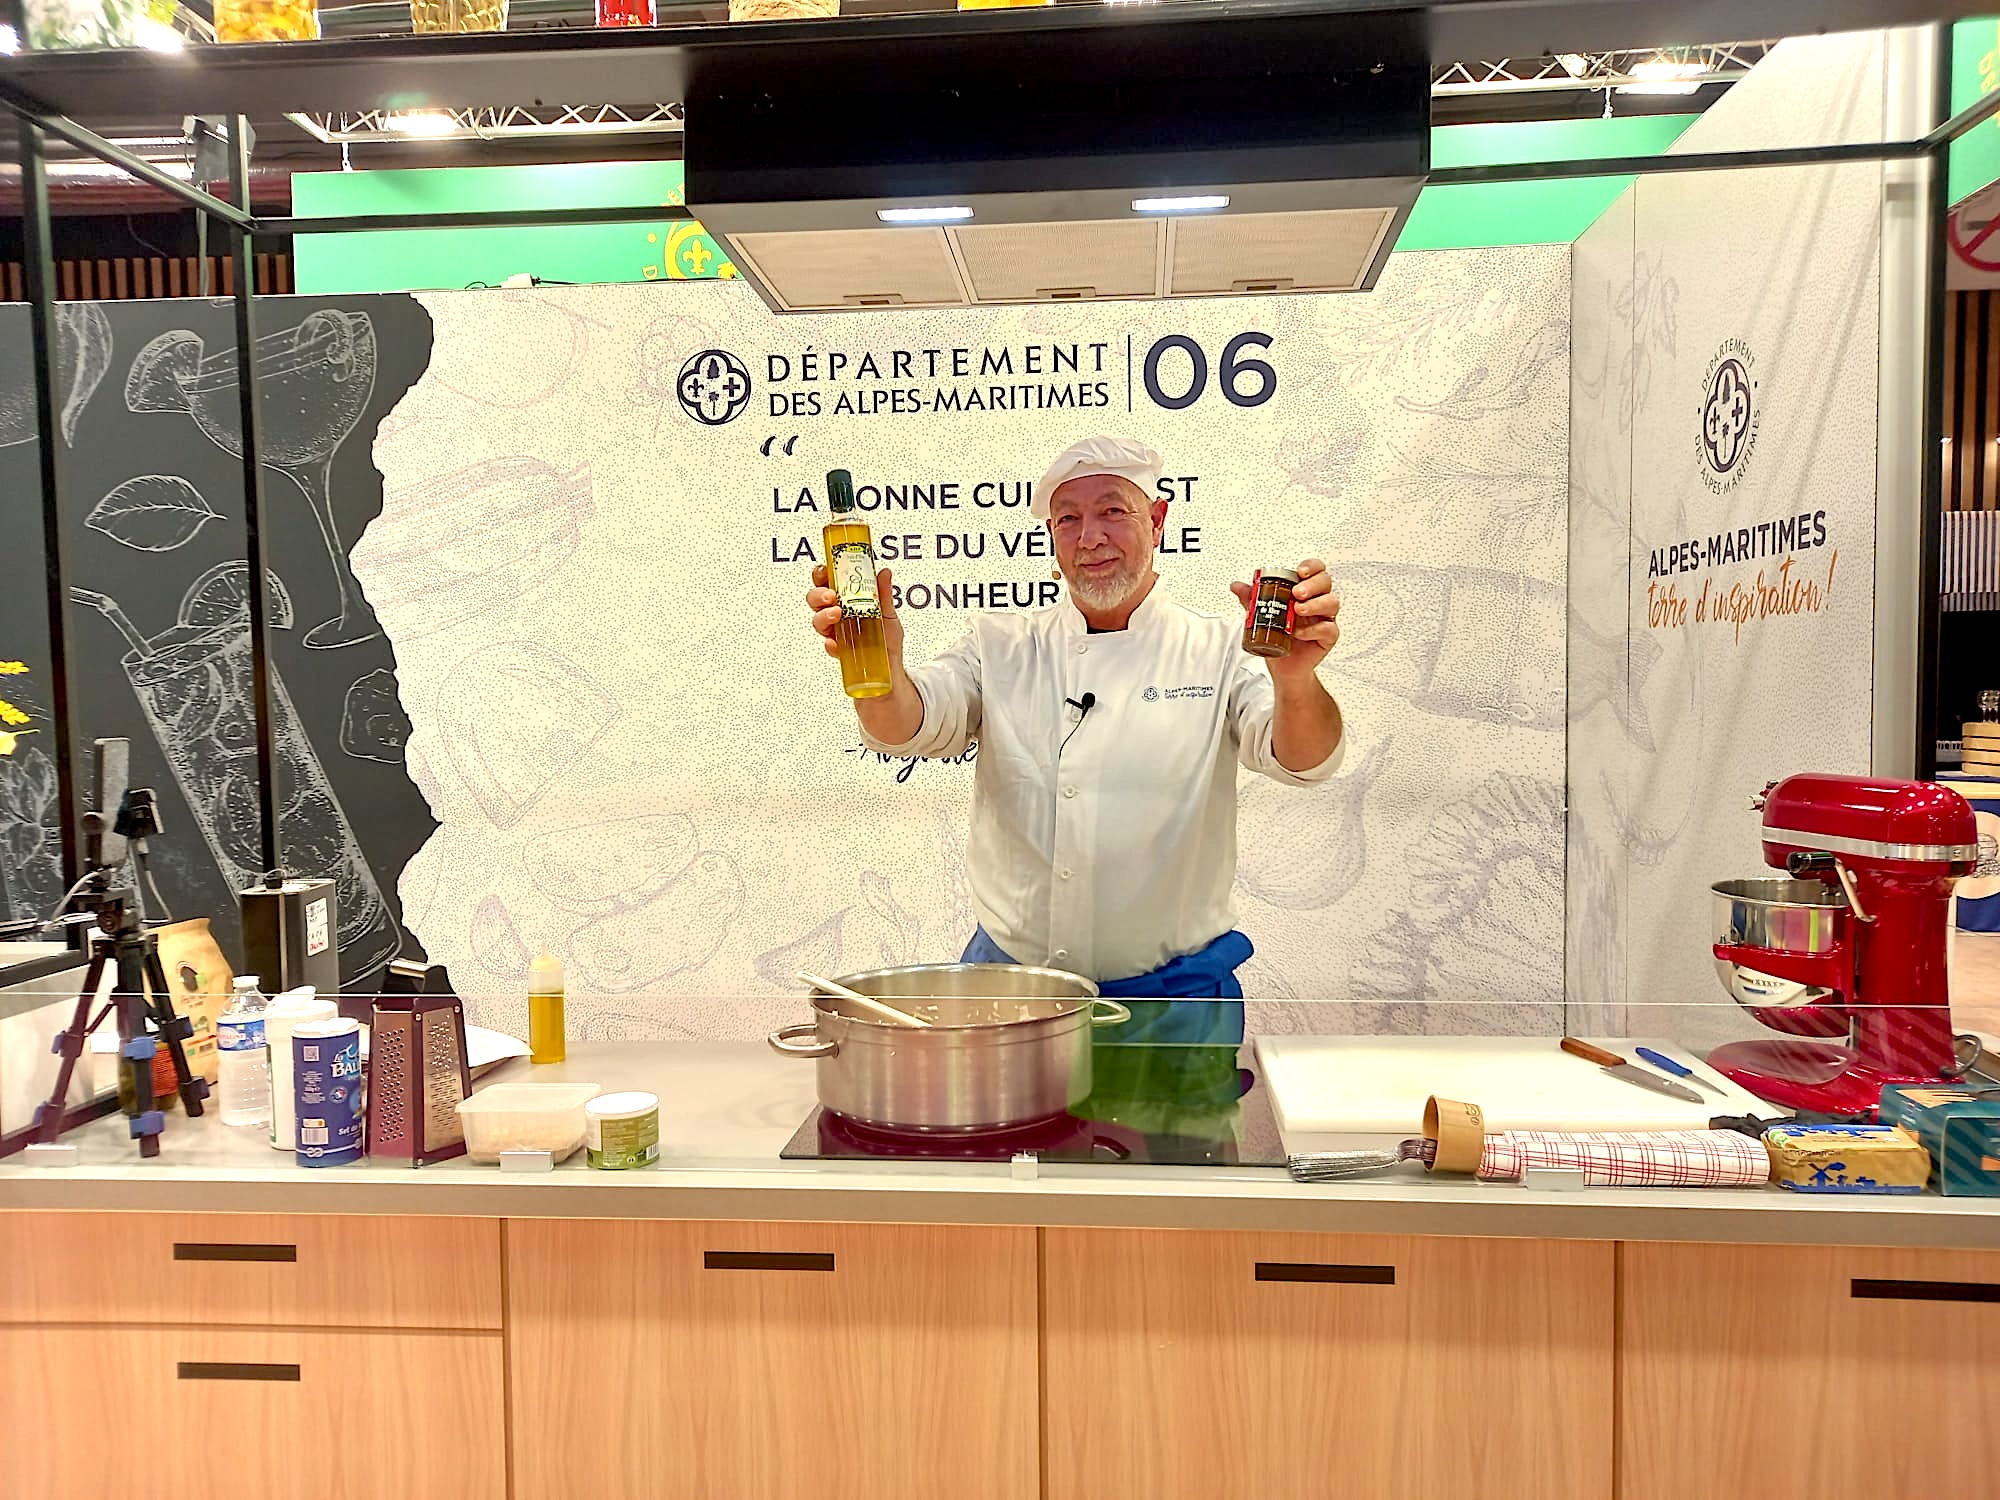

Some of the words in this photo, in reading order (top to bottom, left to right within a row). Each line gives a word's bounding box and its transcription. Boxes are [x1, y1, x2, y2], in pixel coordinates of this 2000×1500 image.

[768, 343, 1108, 382] DÉPARTEMENT
[1144, 331, 1276, 410] 06
[770, 391, 822, 416] DES
[833, 382, 1109, 415] ALPES-MARITIMES
[773, 487, 818, 513] LA
[854, 483, 960, 512] ONNE
[973, 481, 1032, 508] CUI
[1156, 477, 1199, 503] ST
[772, 536, 816, 563] LA
[870, 534, 923, 561] SE
[936, 533, 985, 560] DU
[1648, 510, 1827, 578] ALPES-MARITIMES
[331, 1062, 359, 1078] BAL
